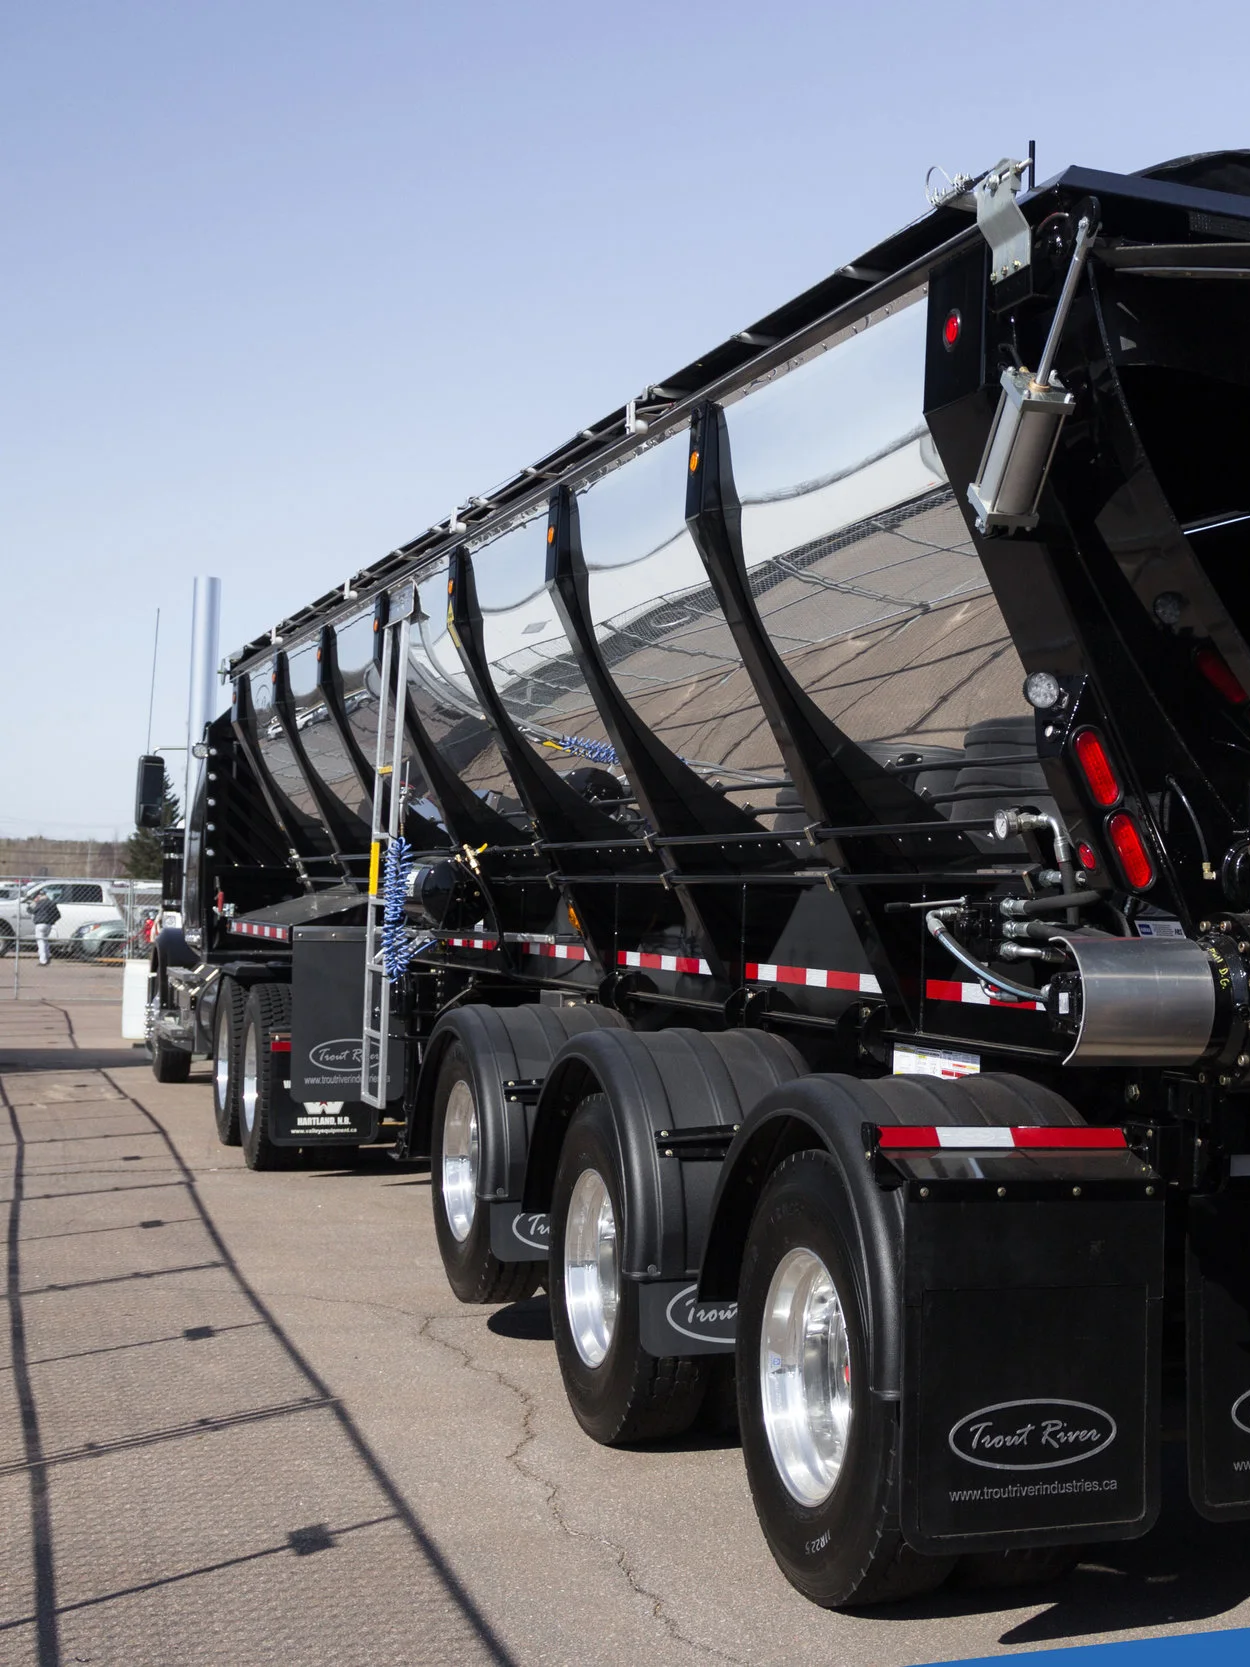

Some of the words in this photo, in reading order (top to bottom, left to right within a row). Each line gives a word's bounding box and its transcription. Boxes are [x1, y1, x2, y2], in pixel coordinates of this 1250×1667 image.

[318, 1048, 350, 1061] Trout
[297, 1117, 336, 1126] HARTLAND,
[969, 1421, 1036, 1450] Trout
[1041, 1419, 1102, 1448] River
[949, 1479, 1118, 1501] www.troutriverindustries.ca
